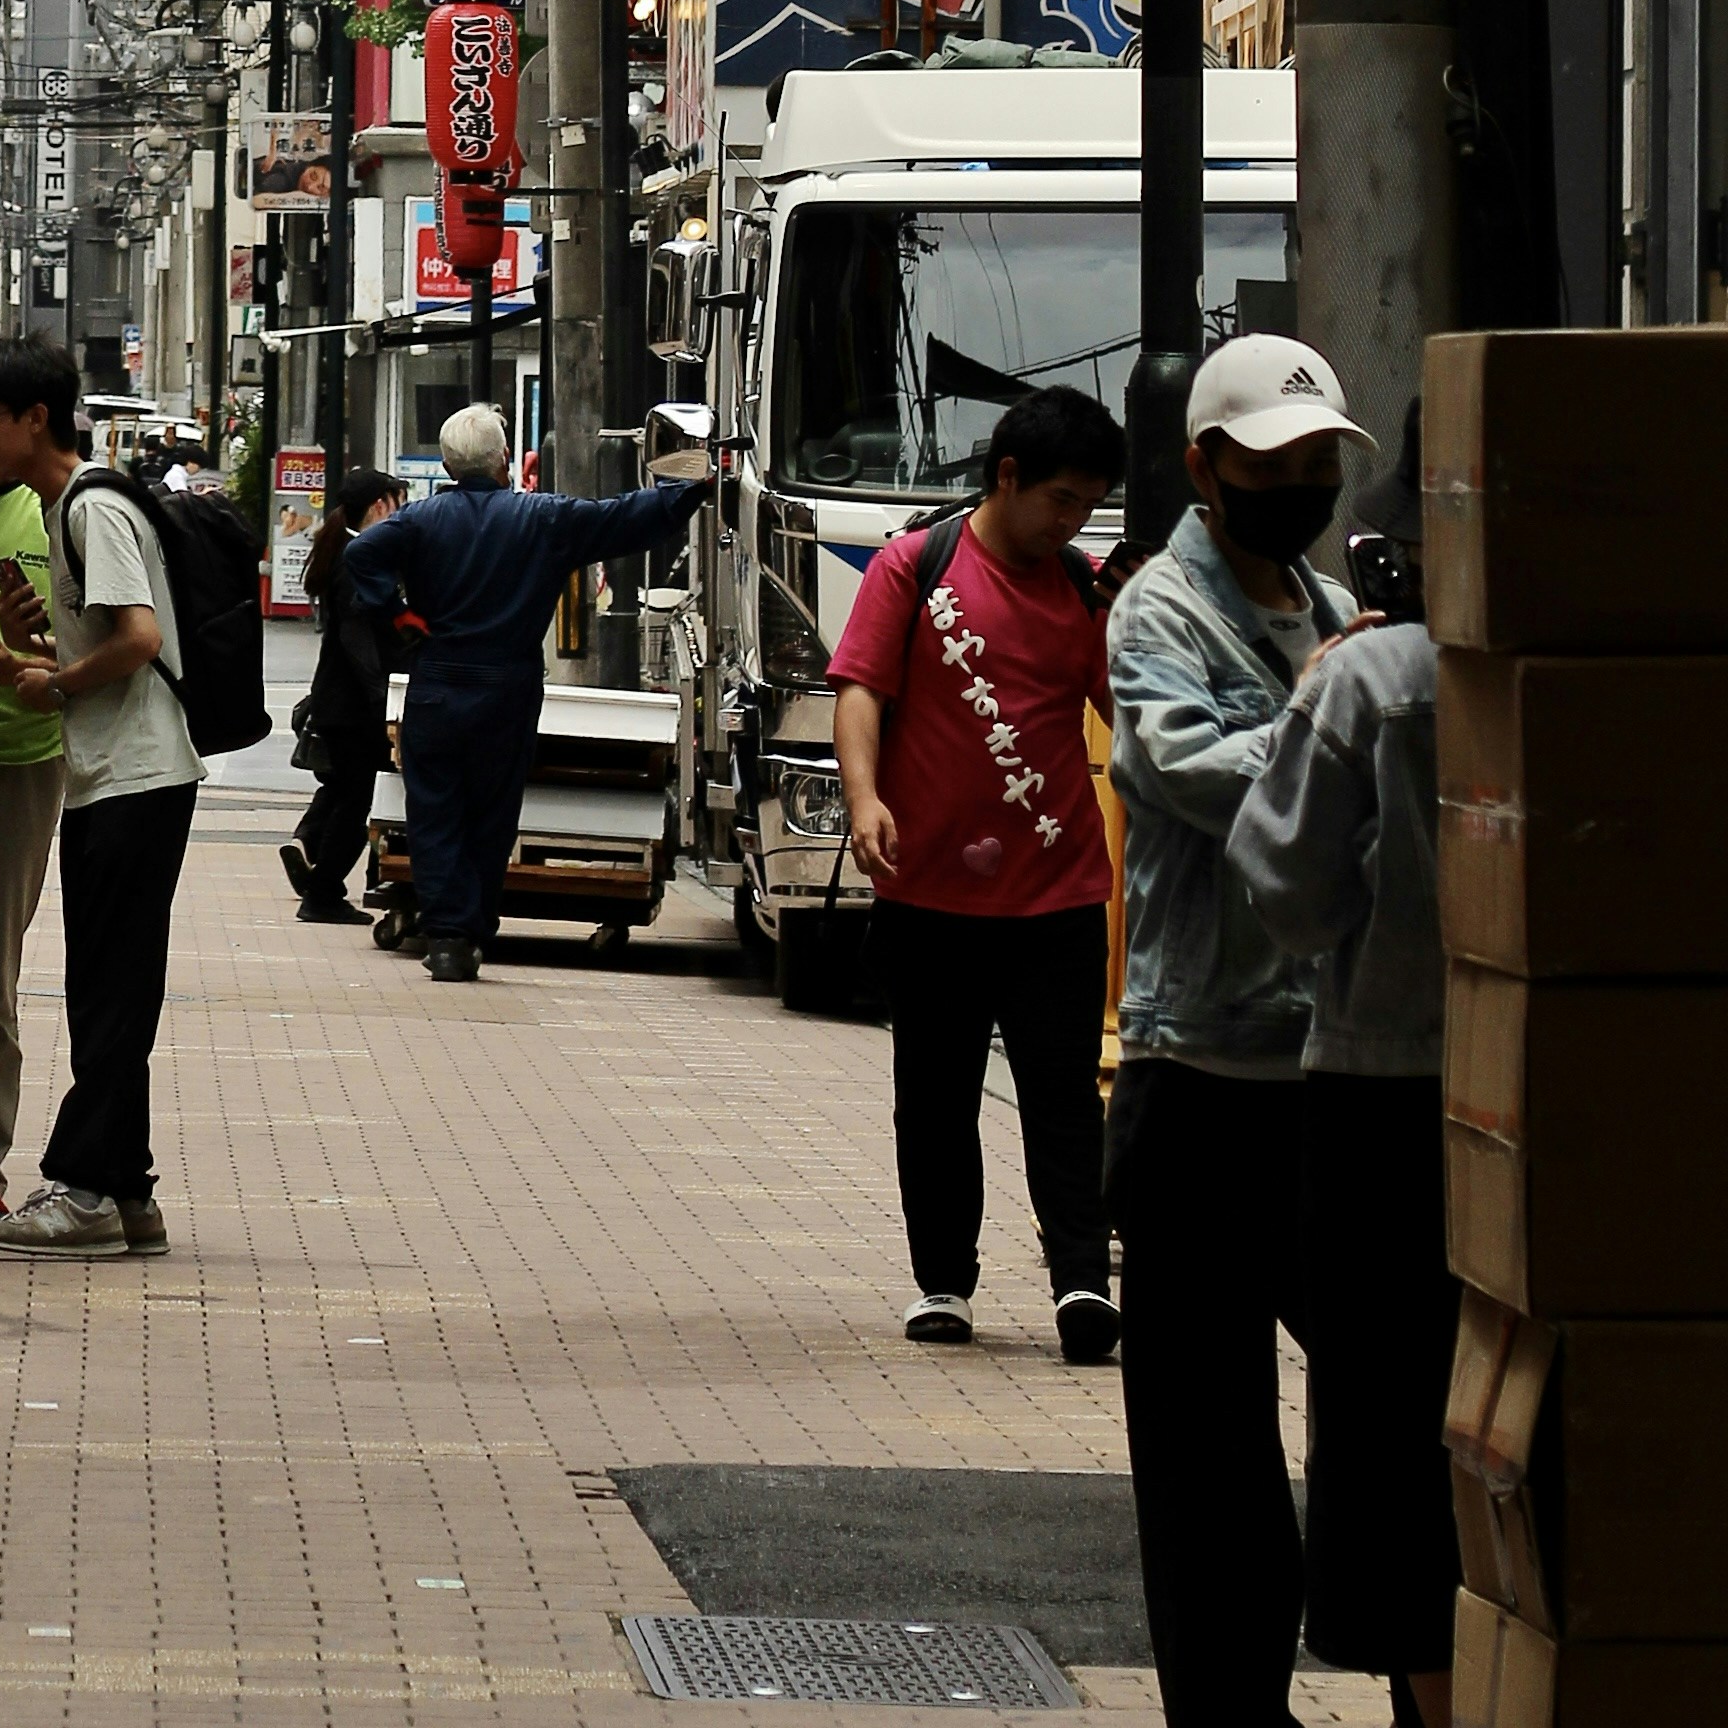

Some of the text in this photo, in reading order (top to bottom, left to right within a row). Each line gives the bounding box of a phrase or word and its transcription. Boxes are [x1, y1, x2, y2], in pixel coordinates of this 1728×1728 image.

[494, 14, 514, 77] 法善寺
[450, 14, 497, 162] こいさん通り
[1280, 382, 1325, 399] adidas
